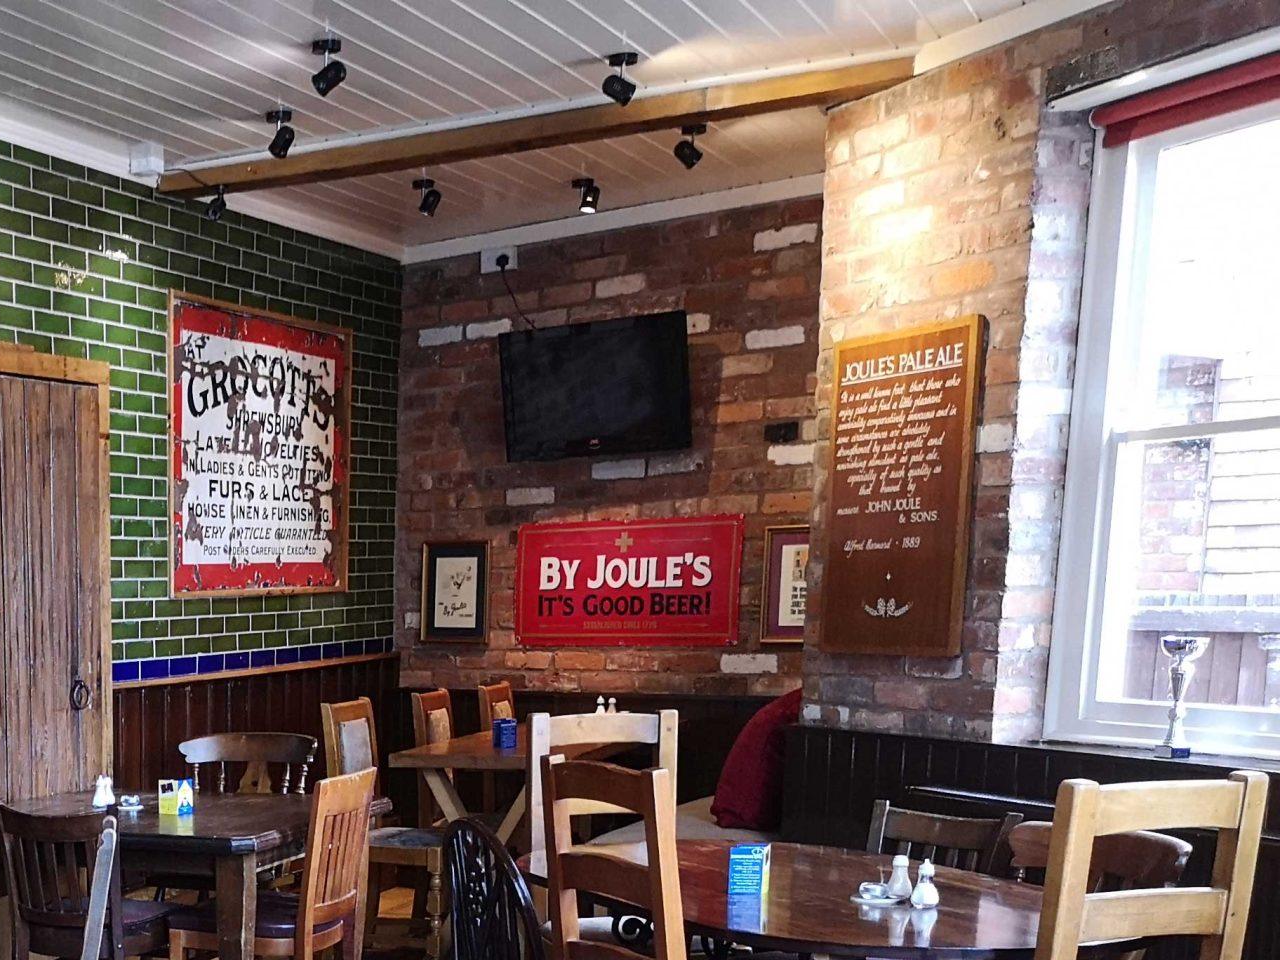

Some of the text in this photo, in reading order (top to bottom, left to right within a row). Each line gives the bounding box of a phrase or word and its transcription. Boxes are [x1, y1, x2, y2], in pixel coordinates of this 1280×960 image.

[899, 348, 934, 372] PALE
[935, 342, 963, 367] ALE
[910, 379, 925, 392] that
[197, 430, 319, 462] LATE OVELTIES
[199, 459, 235, 476] LADIES
[238, 464, 244, 475] &
[209, 480, 310, 502] FURS & LACE
[865, 500, 891, 513] JOHN
[893, 497, 921, 511] JOULE
[263, 508, 269, 520] &
[899, 513, 905, 523] &
[193, 526, 226, 540] ERY
[204, 546, 221, 556] POST
[224, 545, 248, 556] ODERS
[539, 551, 712, 591] BY JOULE'S
[538, 592, 712, 617] IT'S GOOD BEER!
